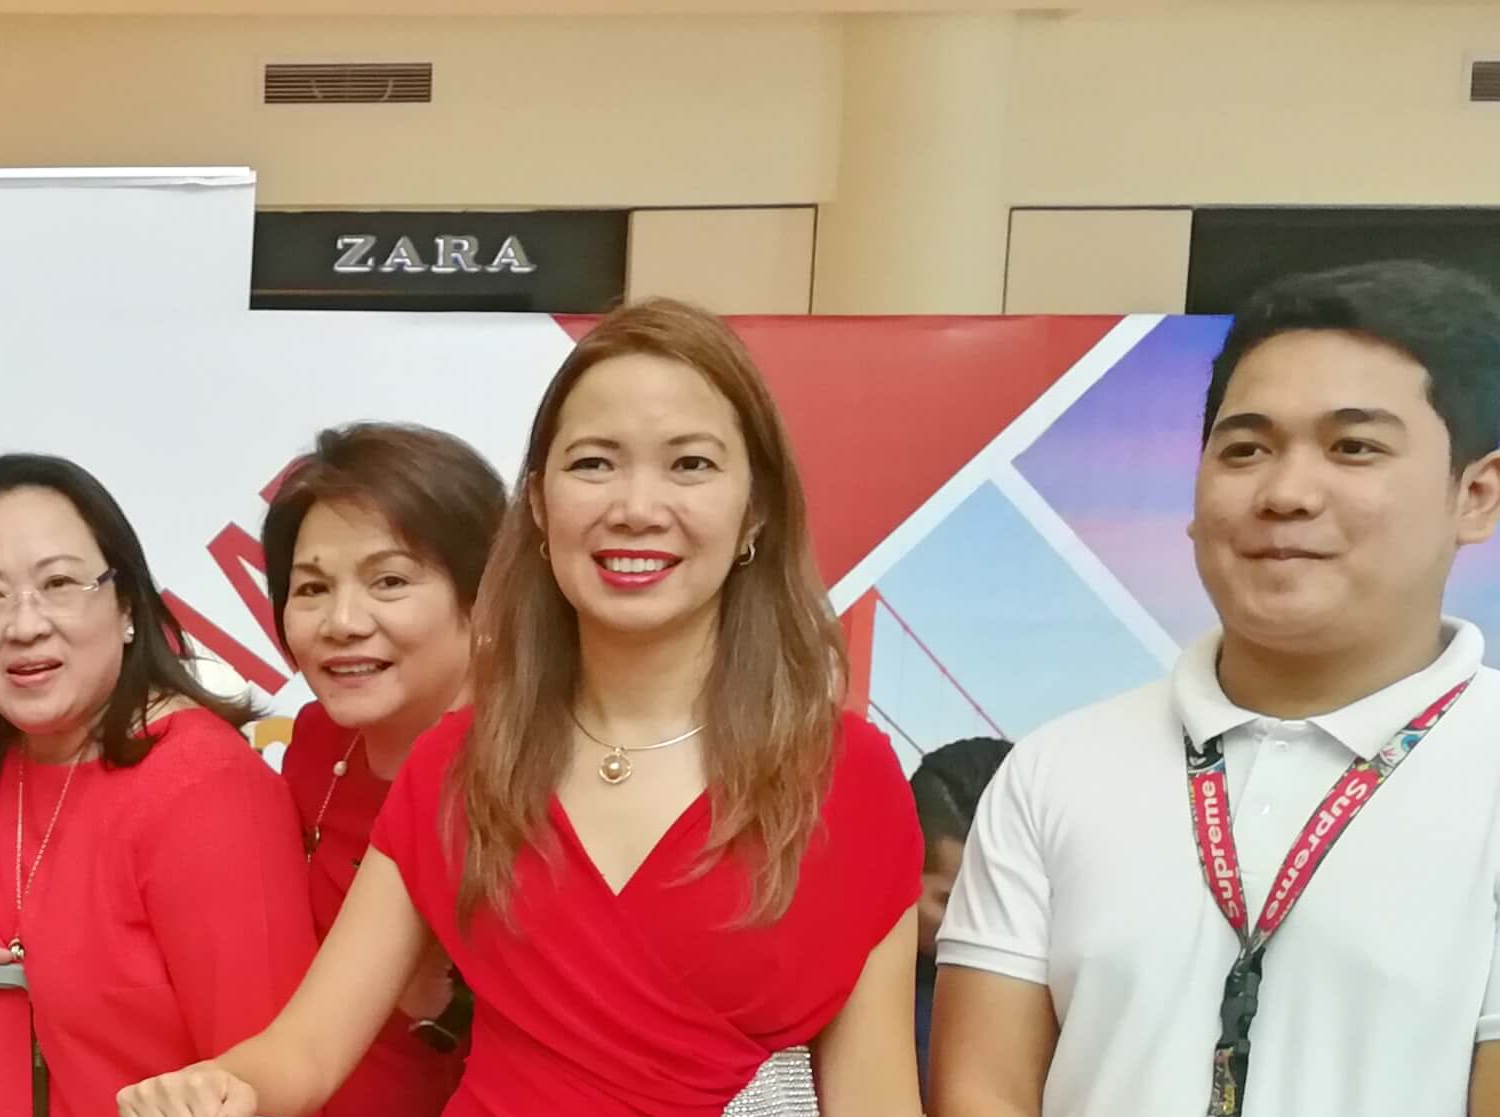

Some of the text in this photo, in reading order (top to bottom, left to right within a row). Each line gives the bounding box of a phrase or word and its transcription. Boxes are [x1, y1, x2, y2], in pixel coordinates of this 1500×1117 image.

[332, 234, 537, 273] ZARA
[1201, 779, 1240, 918] Supreme
[1265, 778, 1369, 921] Supreme
